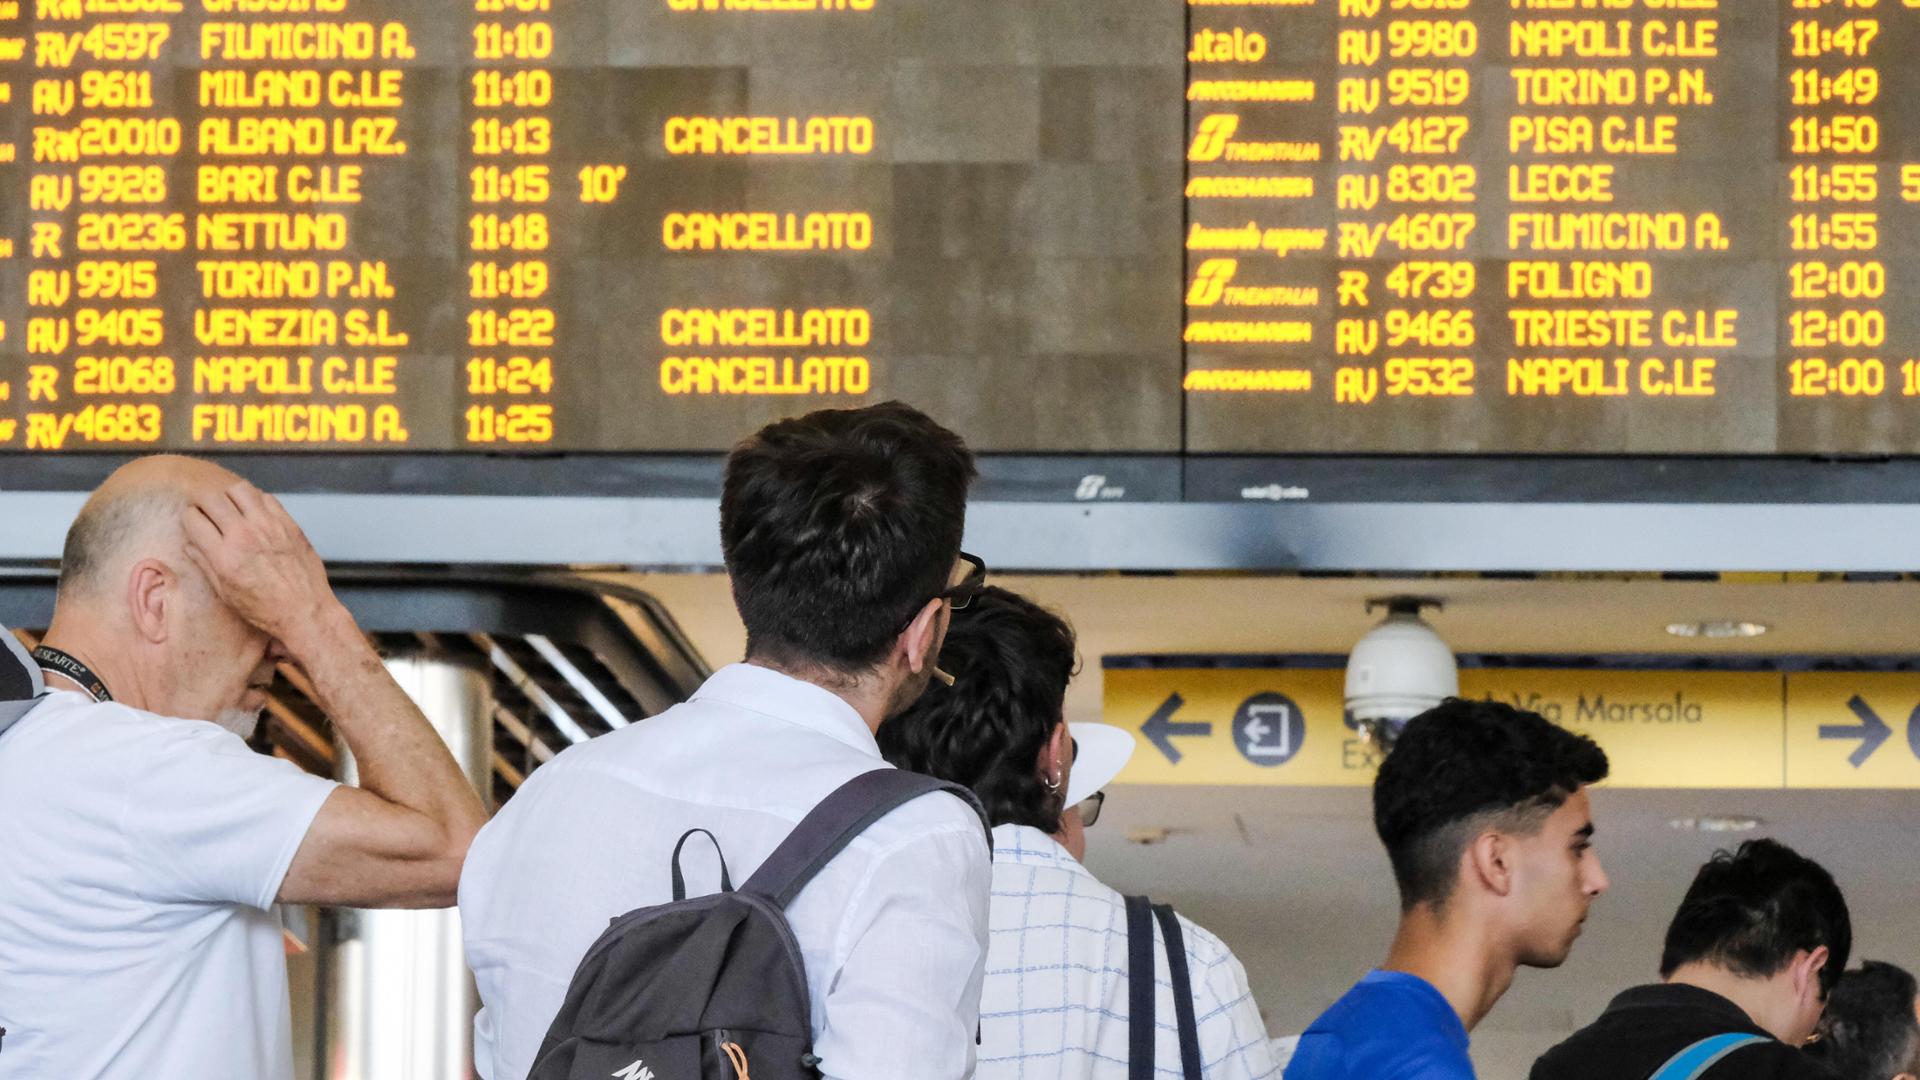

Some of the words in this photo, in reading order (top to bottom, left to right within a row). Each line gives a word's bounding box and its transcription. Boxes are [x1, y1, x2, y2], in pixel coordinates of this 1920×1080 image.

[35, 33, 83, 67] RV
[82, 22, 170, 60] 4597
[201, 22, 376, 60] FIUMICINO
[380, 22, 416, 60] A.
[473, 22, 553, 60] 11:10
[1338, 29, 1381, 66] AV
[1388, 20, 1478, 57] 9980
[1510, 20, 1632, 57] NAPOLI
[1642, 20, 1718, 57] C.LE
[1790, 20, 1878, 56] 11:47
[32, 79, 75, 116] AV
[81, 70, 153, 108] 9611
[199, 69, 321, 108] MILANO
[328, 70, 403, 108] C.LE
[472, 69, 552, 107] 11:10
[1338, 77, 1381, 113] AV
[1386, 68, 1470, 105] 9519
[1511, 68, 1637, 105] TORINO
[1644, 68, 1713, 105] P.N.
[1790, 68, 1878, 104] 11:49
[80, 117, 181, 155] 20010
[198, 117, 327, 156] ALBANO
[332, 117, 407, 156] LAZ.
[471, 117, 551, 155] 11:13
[664, 116, 874, 154] CANCELLATO
[1339, 126, 1387, 161] RV
[1386, 116, 1469, 153] 4127
[1509, 115, 1594, 154] PISA
[1600, 115, 1677, 154] C.LE
[1790, 115, 1878, 153] 11:50
[30, 174, 73, 211] AV
[78, 165, 167, 203] 9928
[197, 165, 279, 203] BARI
[287, 165, 362, 203] C.LE
[470, 165, 550, 203] 11:15
[1337, 174, 1380, 209] AV
[1386, 164, 1476, 202] 8302
[1509, 164, 1614, 202] LECCE
[1789, 164, 1878, 201] 11:55
[32, 222, 63, 258] R
[77, 212, 187, 251] 20236
[196, 212, 347, 250] NETTUNO
[469, 213, 550, 251] 11:18
[663, 212, 873, 250] CANCELLATO
[1339, 222, 1386, 257] RV
[1386, 212, 1476, 250] 4607
[1509, 212, 1687, 250] FIUMICINO
[1694, 212, 1729, 250] A.
[1790, 212, 1877, 250] 11:55
[28, 270, 71, 307] AV
[76, 260, 157, 298] 9915
[196, 260, 321, 298] TORINO
[326, 260, 395, 298] P.N.
[469, 261, 548, 298] 11:19
[1337, 270, 1369, 306] R
[1385, 261, 1475, 298] 4739
[1508, 261, 1652, 299] FOLIGNO
[1789, 261, 1885, 299] 12:00
[27, 317, 70, 354] AV
[75, 308, 163, 346] 9405
[194, 308, 338, 346] VENEZIA
[344, 308, 408, 346] S.L.
[467, 308, 555, 346] 11:22
[660, 308, 871, 346] CANCELLATO
[1335, 319, 1379, 355] AV
[1385, 309, 1475, 347] 9466
[1508, 308, 1653, 347] TRIESTE
[1662, 309, 1737, 347] C.LE
[1789, 309, 1885, 347] 12:00
[28, 365, 59, 401] R
[74, 356, 176, 394] 21068
[193, 356, 313, 394] NAPOLI
[322, 356, 397, 394] C.LE
[466, 356, 553, 394] 11:24
[660, 356, 870, 394] CANCELLATO
[1335, 367, 1378, 403] AV
[1385, 357, 1475, 395] 9532
[1507, 357, 1630, 395] NAPOLI
[1640, 358, 1716, 396] C.LE
[1789, 358, 1885, 395] 12:00
[26, 413, 74, 449] RV
[73, 404, 161, 442] 4683
[192, 404, 367, 442] FIUMICINO
[373, 404, 408, 442] A.
[466, 404, 552, 442] 11:25
[1575, 691, 1702, 722] Marsala
